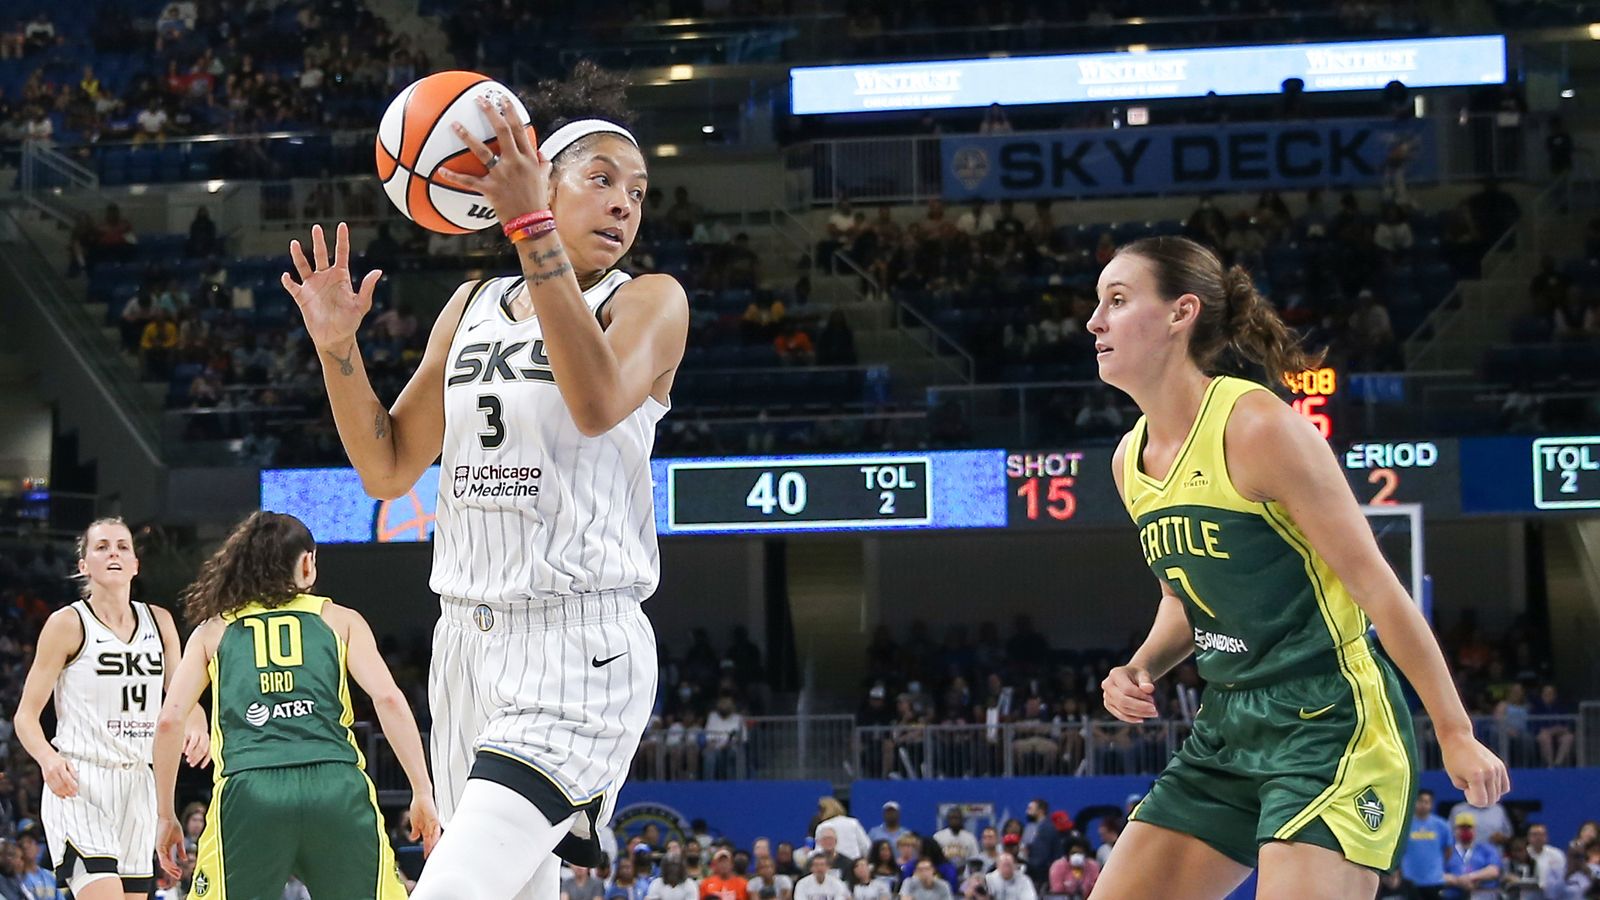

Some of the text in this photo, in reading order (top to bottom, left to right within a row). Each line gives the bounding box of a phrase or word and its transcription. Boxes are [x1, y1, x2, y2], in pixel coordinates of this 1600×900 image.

[1000, 129, 1376, 189] SKY DECK
[476, 394, 507, 450] 3
[1006, 453, 1083, 478] SHOT
[1346, 442, 1438, 468] ERIOD
[1541, 446, 1600, 471] TOL
[472, 465, 542, 480] UChicago
[860, 465, 916, 490] TOL
[1560, 471, 1578, 493] 2
[468, 481, 539, 497] Medicine
[746, 471, 807, 515] 40
[1017, 477, 1076, 520] 15
[1367, 468, 1399, 506] 2
[879, 490, 896, 514] 2
[1139, 516, 1230, 567] EATTLE
[1164, 566, 1216, 619] 7
[243, 615, 303, 668] 10
[96, 652, 163, 676] SKY
[260, 670, 294, 694] BIRD
[122, 684, 147, 711] 14
[272, 700, 315, 718] AT&T
